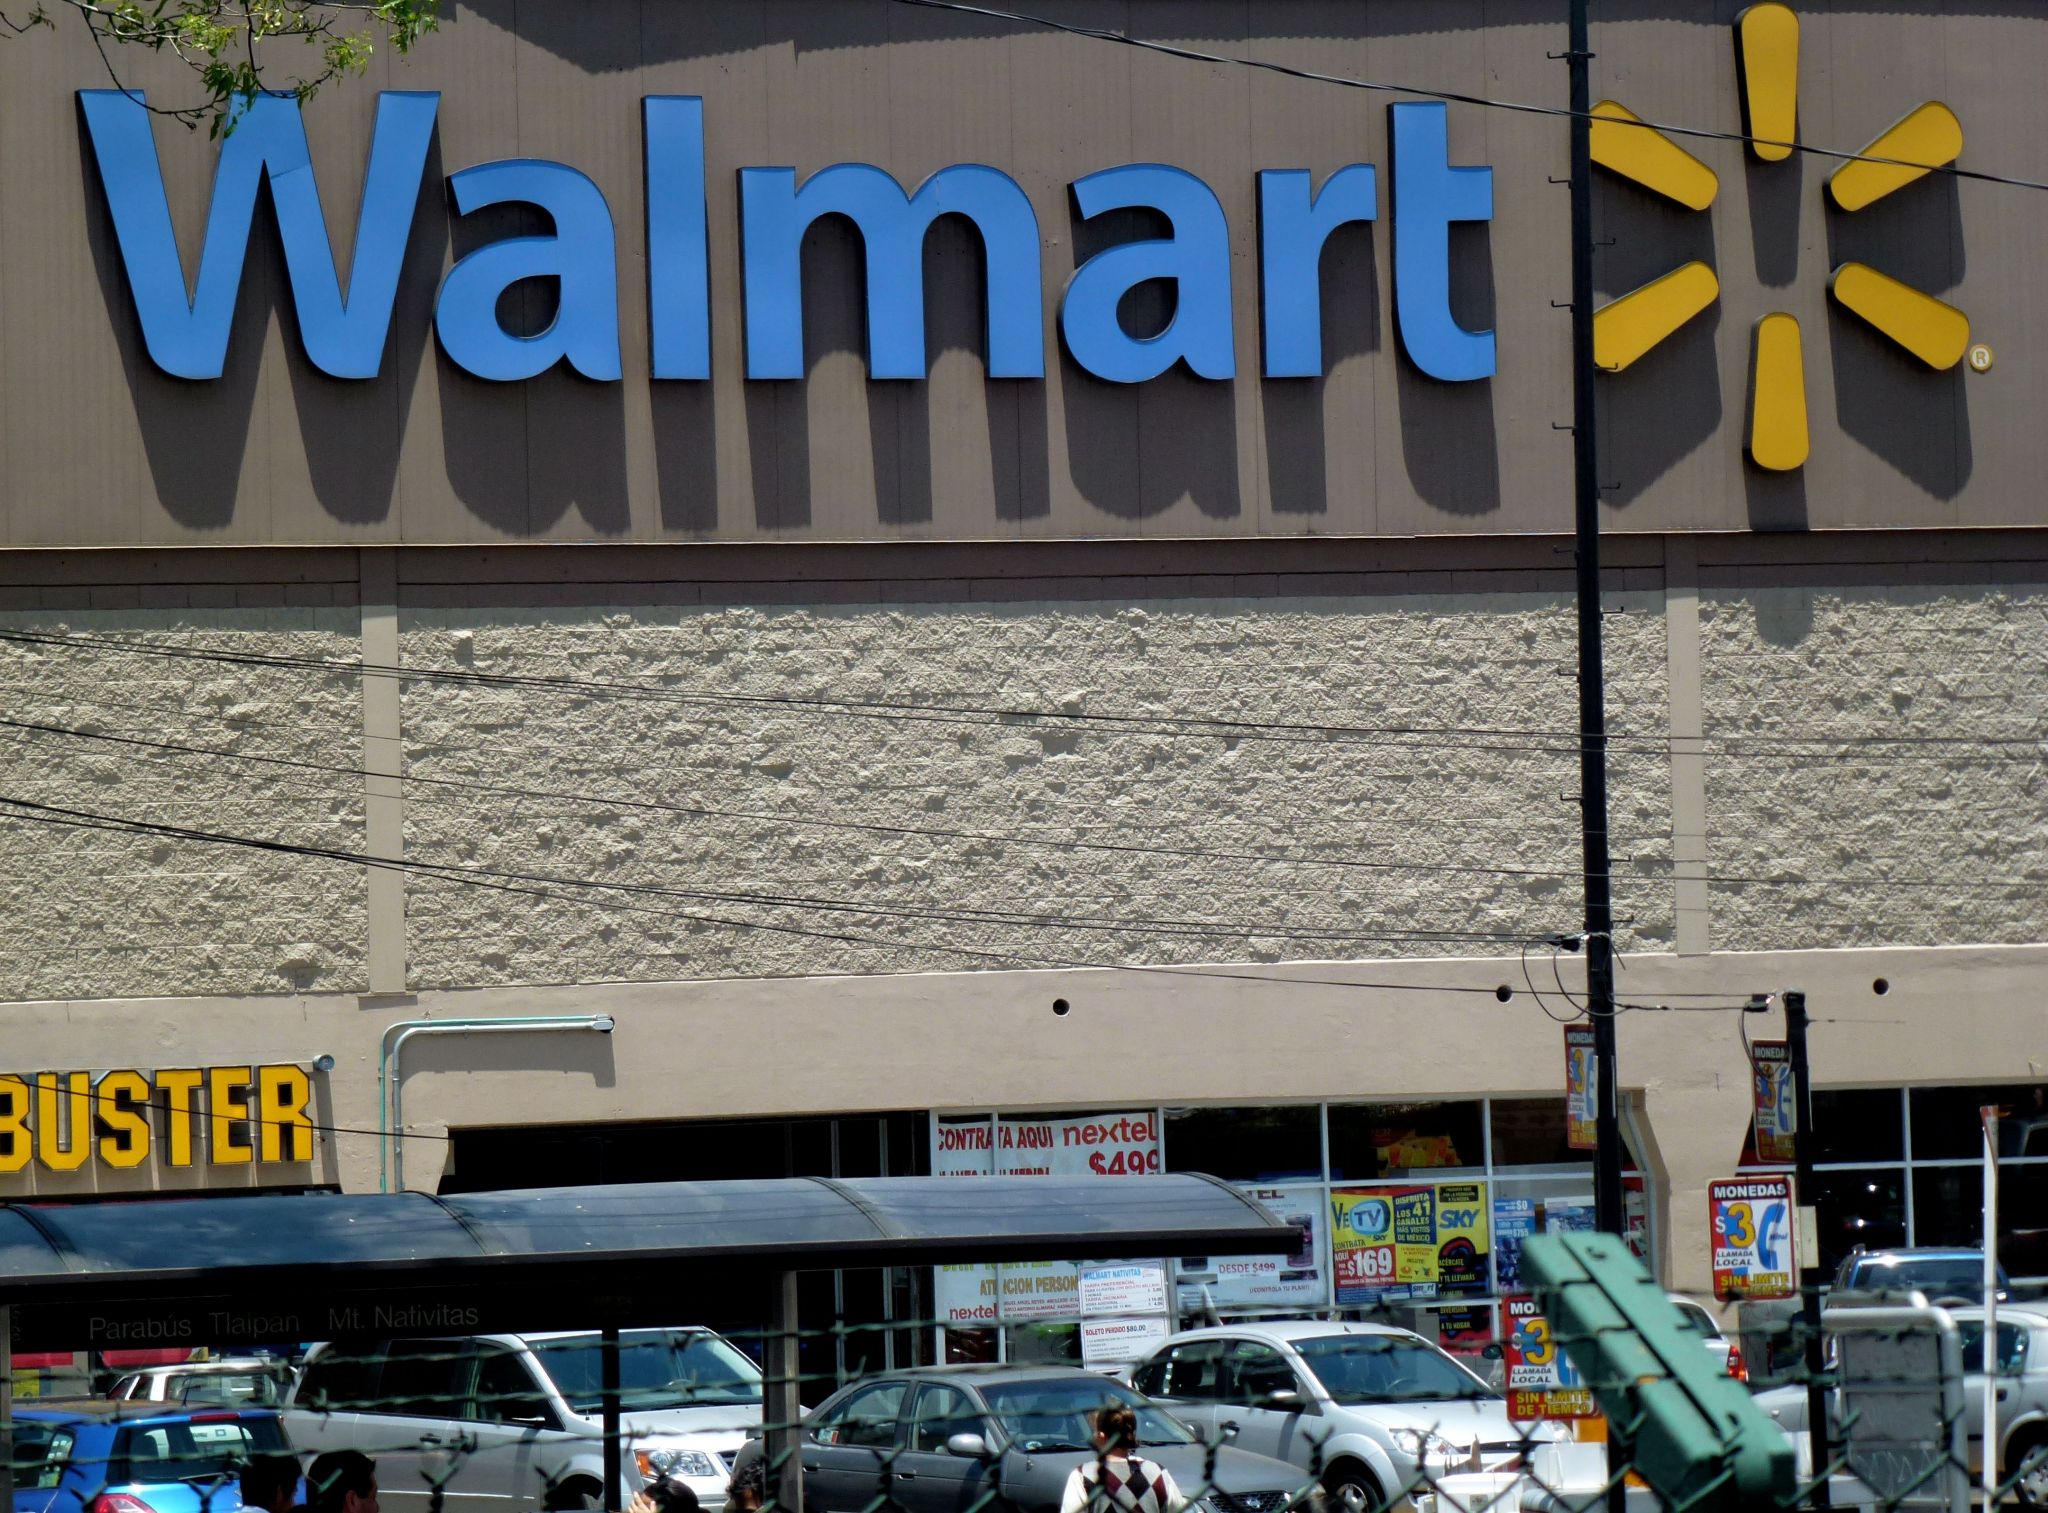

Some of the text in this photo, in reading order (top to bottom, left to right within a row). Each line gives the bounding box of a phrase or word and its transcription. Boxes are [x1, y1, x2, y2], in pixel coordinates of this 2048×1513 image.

[75, 89, 1496, 383] Walmart
[1754, 1046, 1786, 1059] MONEDA
[0, 1063, 314, 1173] BUSTER
[1016, 1125, 1054, 1150] AQUI
[1062, 1112, 1159, 1147] nextel
[1713, 1183, 1787, 1199] MONEDAS
[1353, 1208, 1382, 1227] TV
[1396, 1201, 1431, 1218] LOS 41
[1396, 1216, 1430, 1226] CANALES
[1439, 1208, 1481, 1230] SKY
[1717, 1250, 1754, 1258] LLAMADA
[1218, 1262, 1276, 1274] DESDE $499
[1347, 1247, 1393, 1278] $169
[1715, 1258, 1754, 1267] LOCAL
[1720, 1275, 1741, 1287] SIN
[949, 1302, 998, 1320] nextel
[88, 1313, 193, 1341] Parabús
[328, 1307, 366, 1331] Mt.
[374, 1303, 480, 1328] Nativitas
[1512, 1367, 1552, 1375] LLAMADA
[1511, 1376, 1552, 1384] LOCAL
[1516, 1392, 1540, 1404] SIN
[1517, 1403, 1590, 1416] DE TIEMPO
